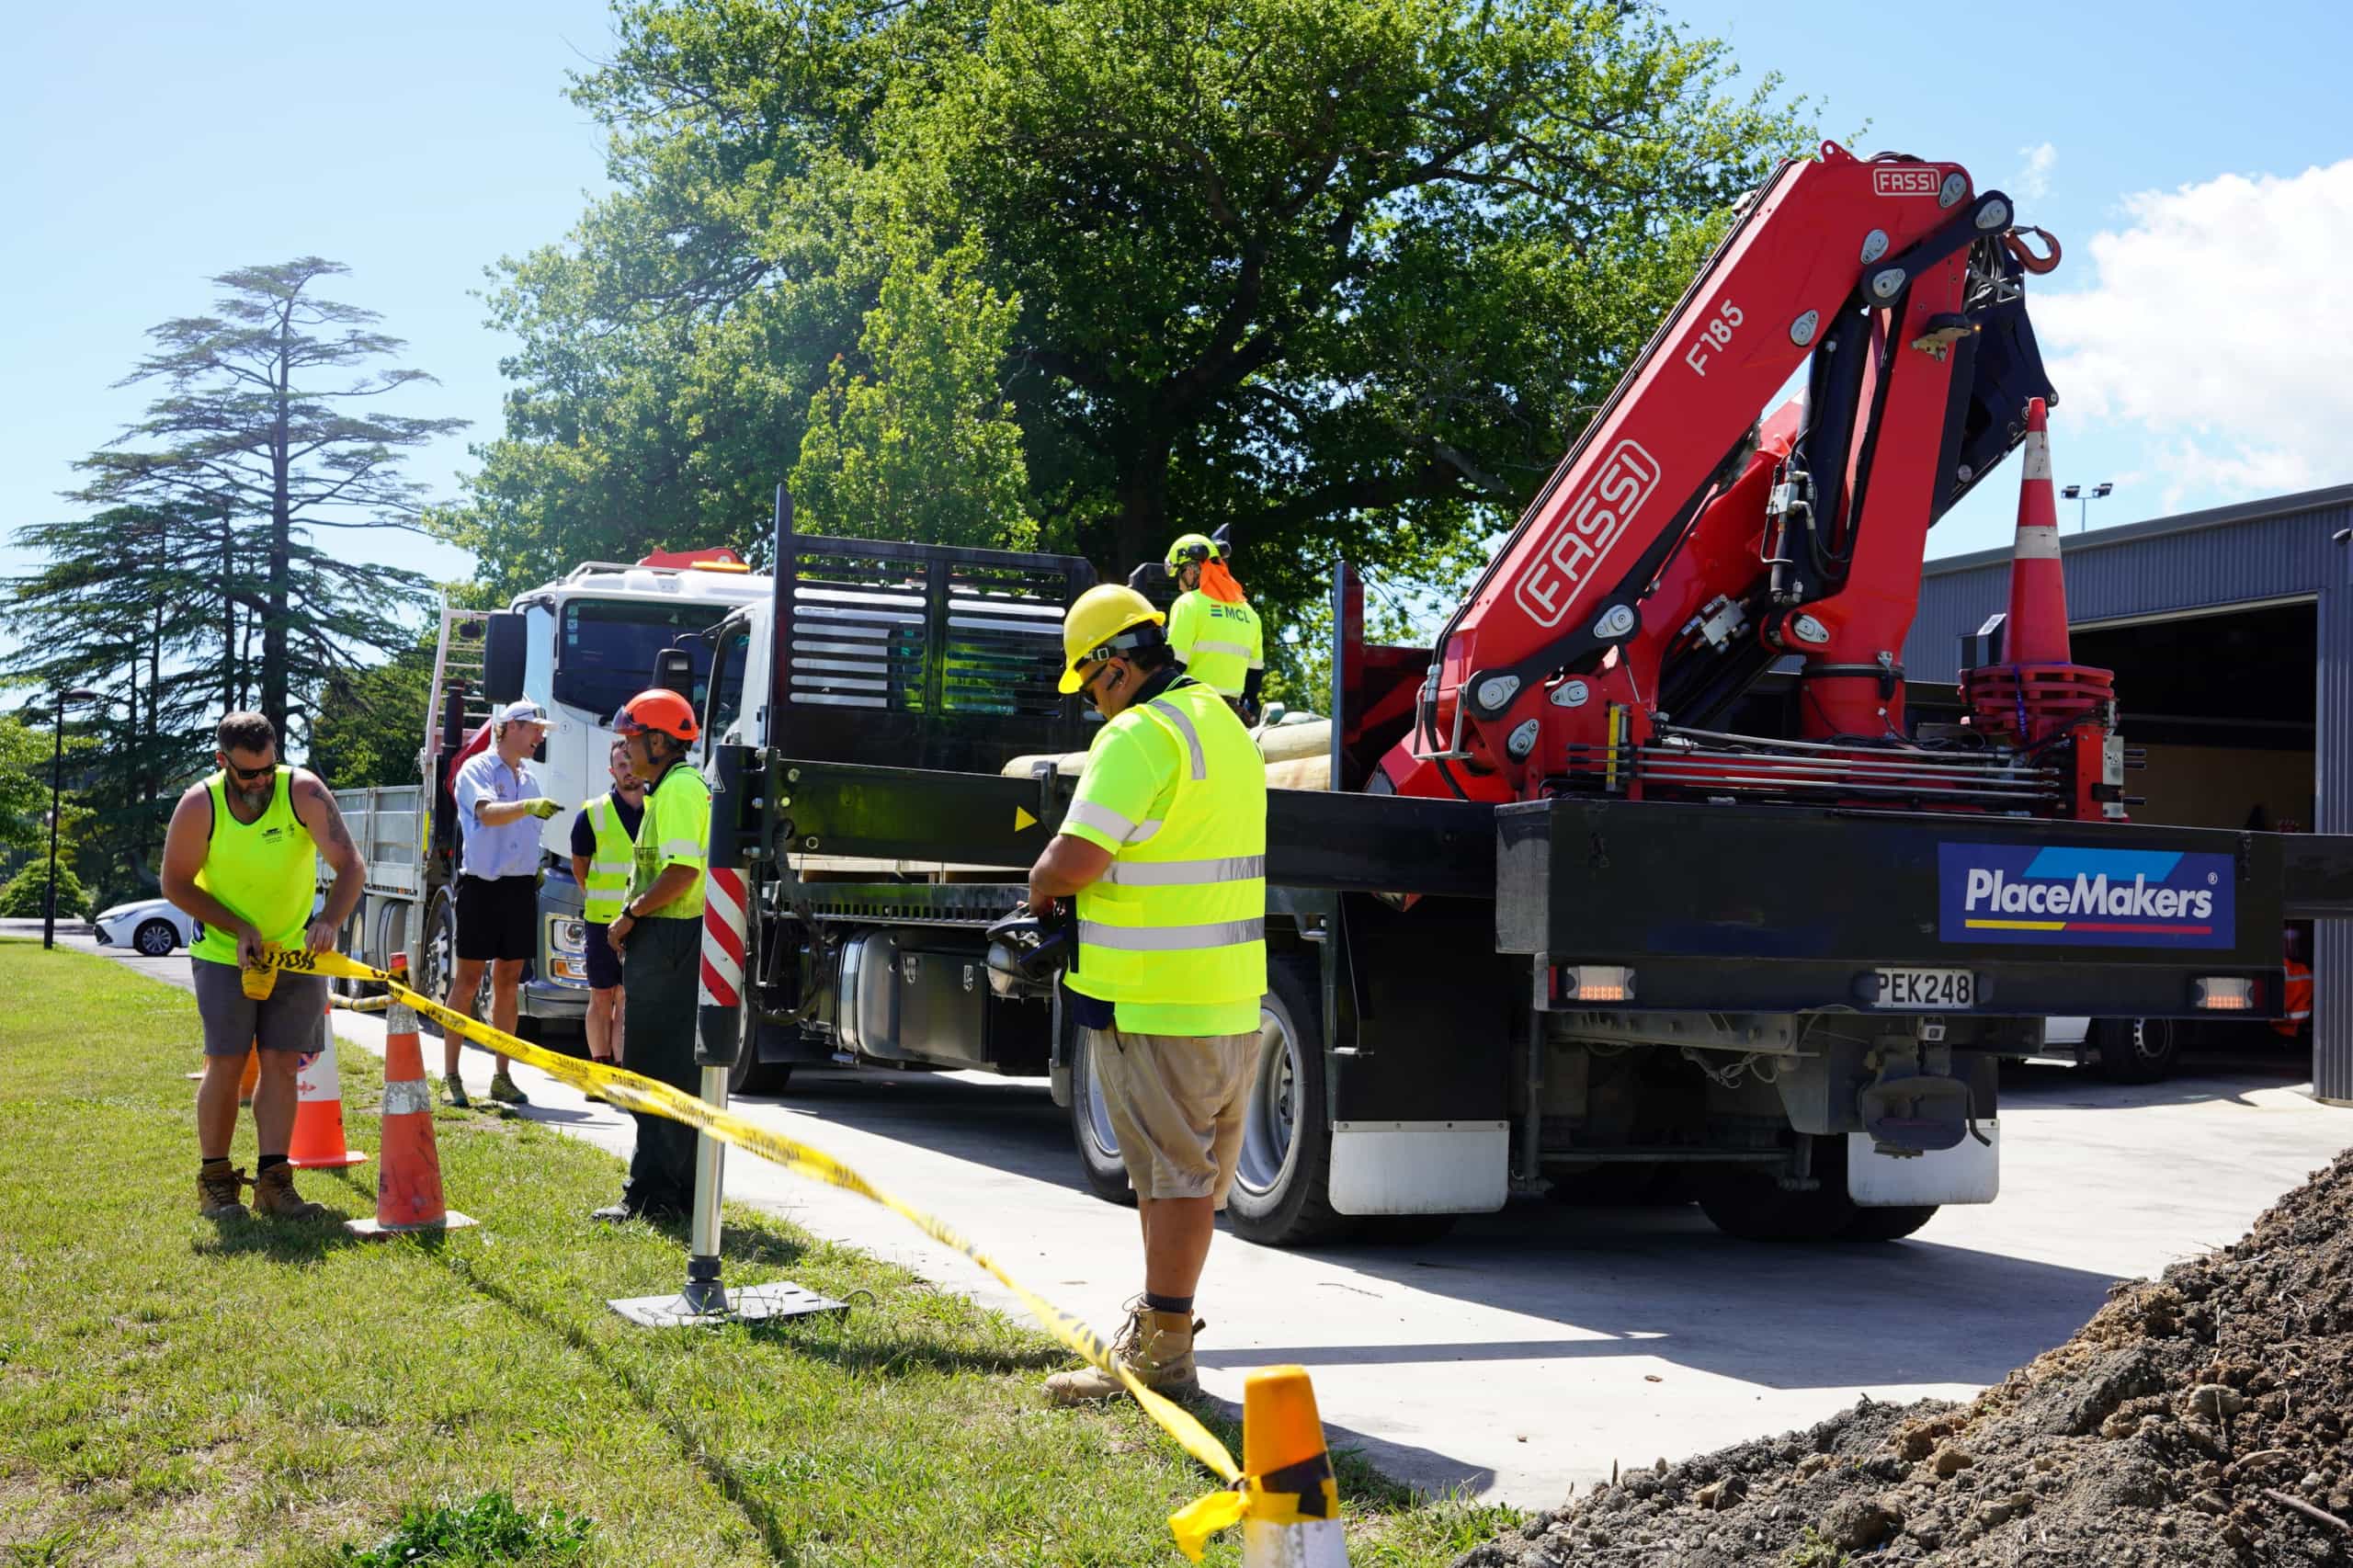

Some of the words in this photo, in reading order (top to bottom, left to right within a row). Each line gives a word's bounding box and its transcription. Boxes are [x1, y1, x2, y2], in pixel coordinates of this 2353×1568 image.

[1879, 173, 1935, 191] FASSI
[1685, 299, 1744, 377] F185
[1527, 453, 1650, 613] FASSI
[1224, 605, 1251, 623] MCL
[1875, 972, 1971, 1004] PEK248
